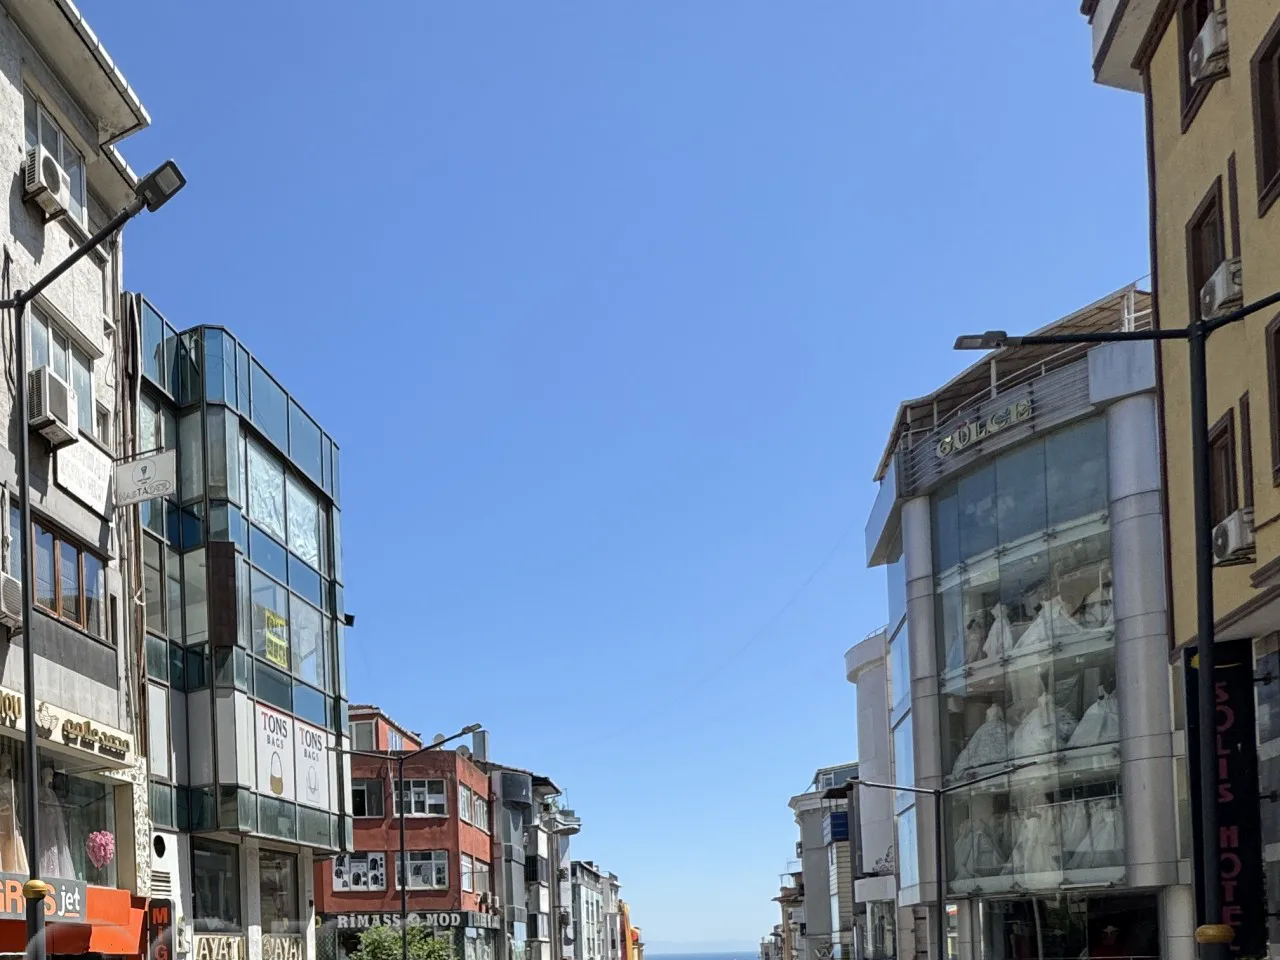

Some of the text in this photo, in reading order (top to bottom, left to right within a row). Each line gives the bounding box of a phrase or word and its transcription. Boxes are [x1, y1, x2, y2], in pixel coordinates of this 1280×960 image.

[261, 710, 288, 739] TONS
[266, 734, 284, 750] BAGS
[299, 726, 323, 752] TONS
[303, 748, 320, 763] BAGS
[58, 886, 81, 917] jet
[426, 913, 461, 927] MOD
